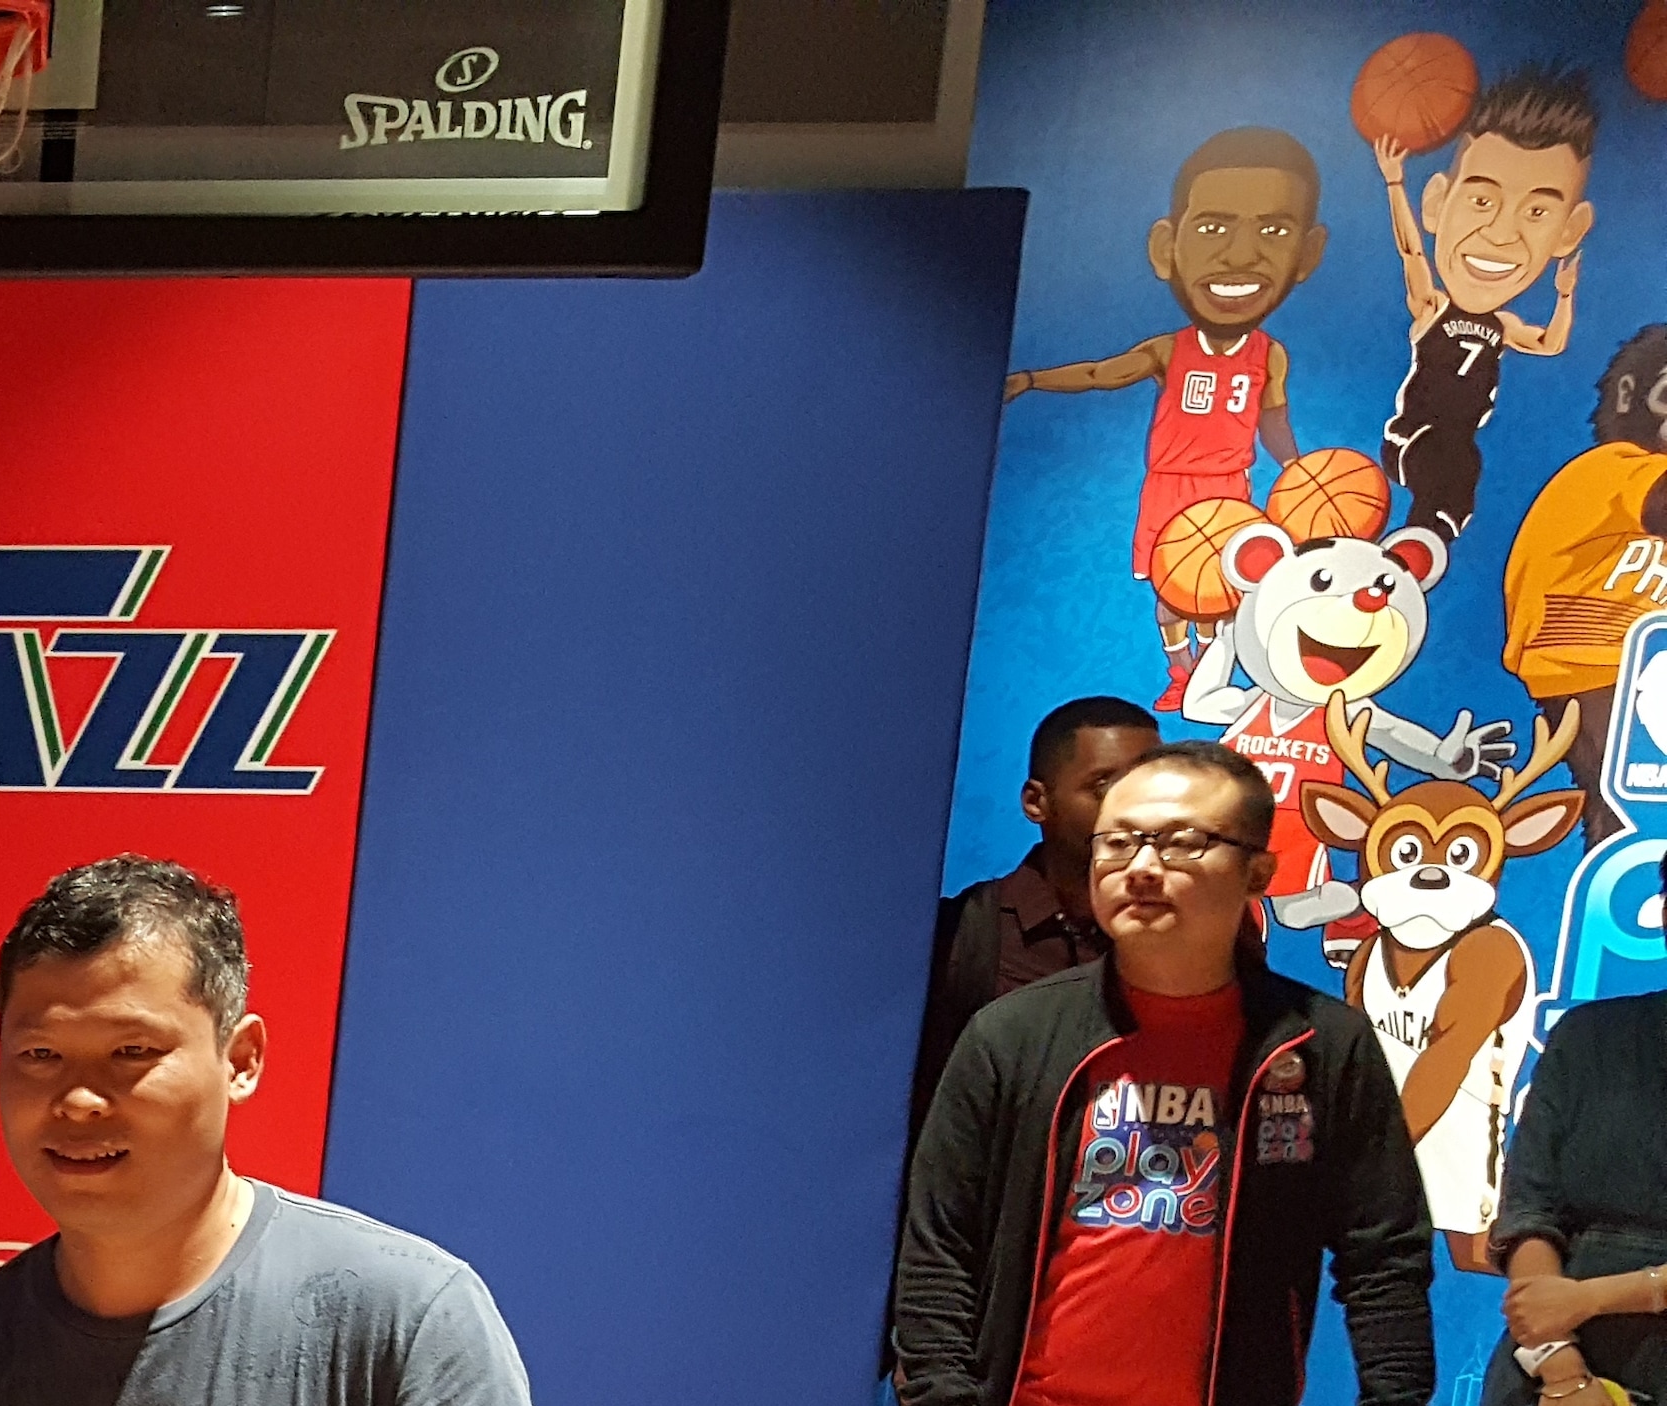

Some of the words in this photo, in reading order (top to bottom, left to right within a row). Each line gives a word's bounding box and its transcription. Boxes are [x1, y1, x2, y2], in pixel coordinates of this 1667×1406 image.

[340, 88, 588, 151] SPALDING
[1441, 318, 1502, 348] BROOKLYN
[1459, 340, 1485, 377] 7
[1226, 374, 1251, 414] 3
[1235, 732, 1331, 766] ROCKETS
[1124, 1083, 1215, 1128] NBA
[1082, 1130, 1220, 1196] play
[1070, 1180, 1217, 1228] zone
